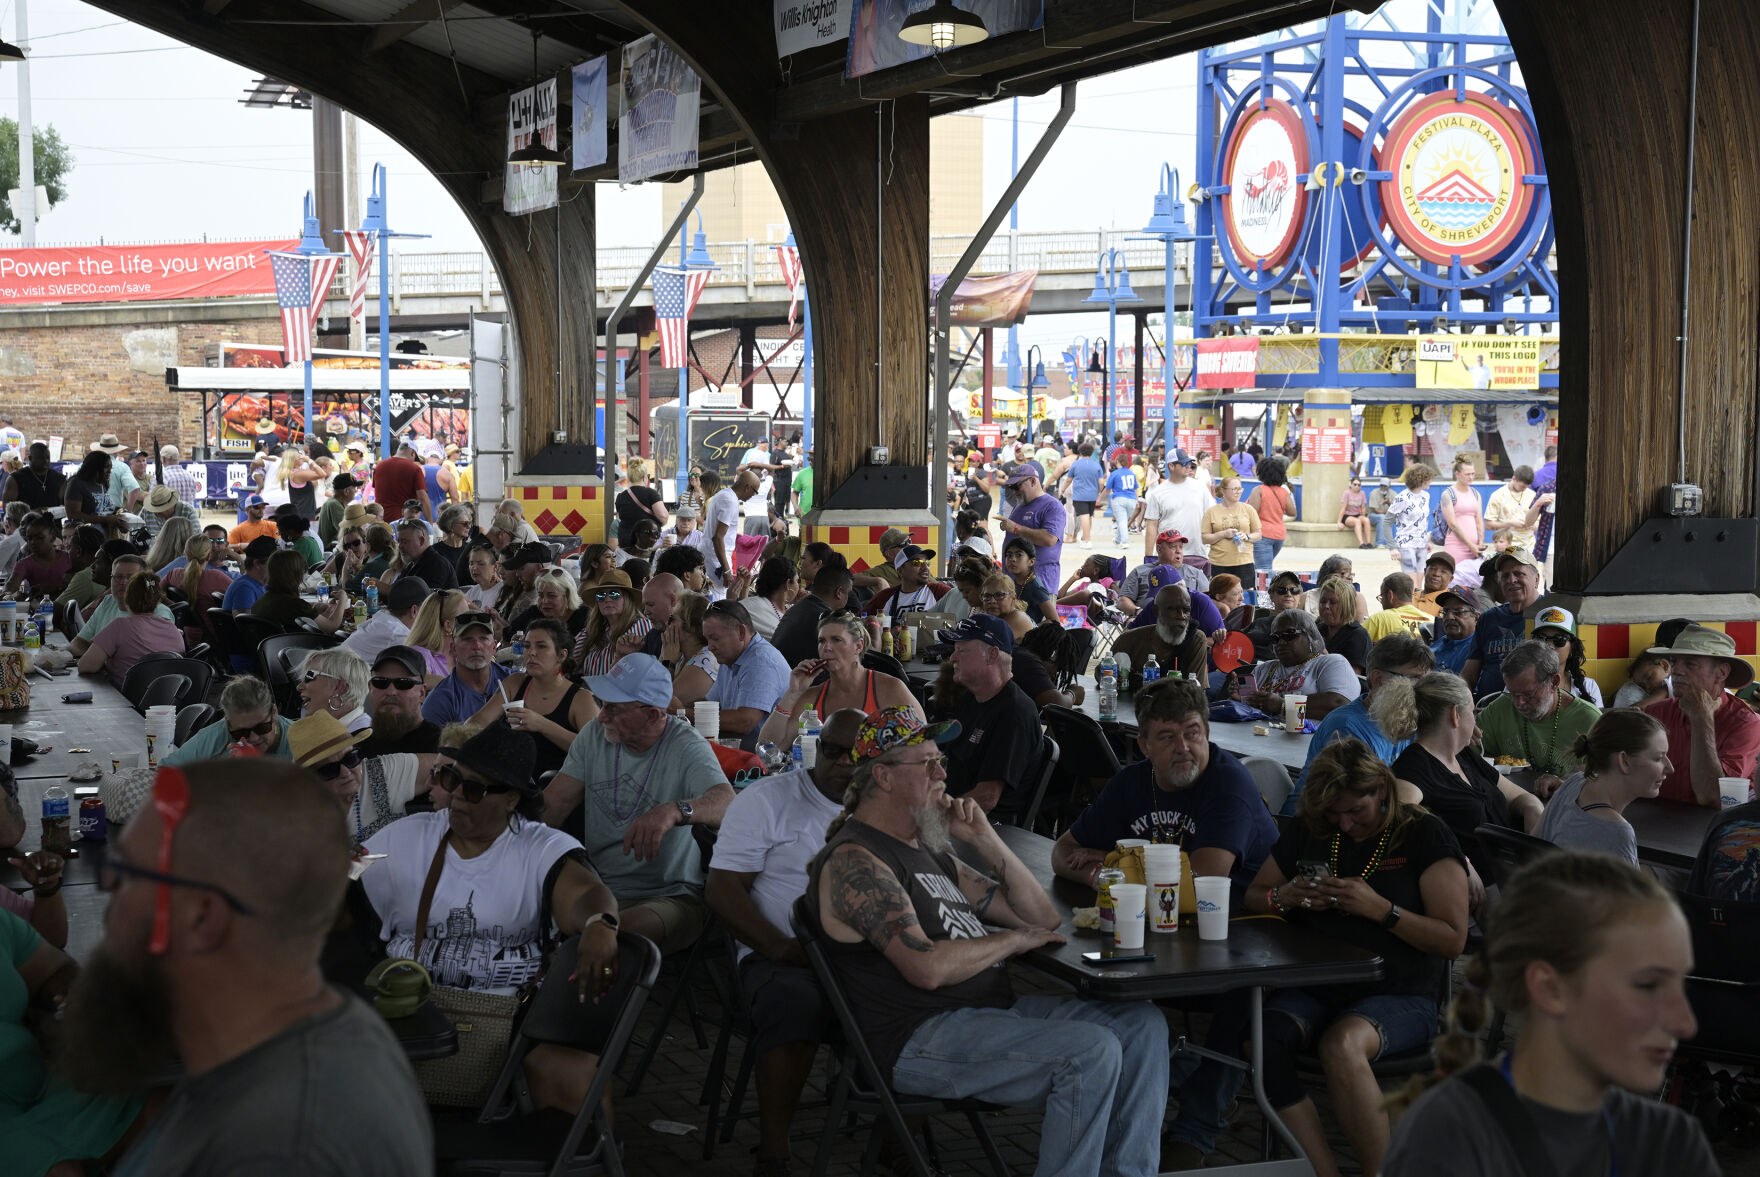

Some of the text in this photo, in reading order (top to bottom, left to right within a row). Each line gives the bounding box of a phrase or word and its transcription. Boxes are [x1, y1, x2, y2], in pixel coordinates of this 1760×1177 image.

[780, 0, 837, 32] Willis Knighton
[817, 22, 837, 39] Health
[1413, 117, 1502, 152] FESTIVAL PLAZA
[1403, 186, 1509, 240] CITY OF SHREVEPORT
[1241, 216, 1267, 227] MADNESS
[1, 253, 256, 277] Power the life you want
[22, 285, 46, 296] visit
[48, 281, 151, 295] SWEPCO.com/save
[1423, 344, 1450, 353] UAPI
[1492, 341, 1519, 349] DON'T
[1521, 341, 1537, 349] SEE
[1489, 351, 1536, 360] THIS LOGO
[1494, 366, 1536, 374] YOU'RE IN THE
[1494, 376, 1536, 385] WRONG PLACE
[373, 397, 421, 408] SAVER'S
[226, 440, 251, 448] FISH
[703, 424, 754, 461] Sophie's
[229, 471, 246, 481] Lite
[1121, 474, 1135, 490] 10
[1398, 534, 1414, 547] FILA
[1130, 814, 1149, 836] MY
[1150, 810, 1182, 825] BUCK
